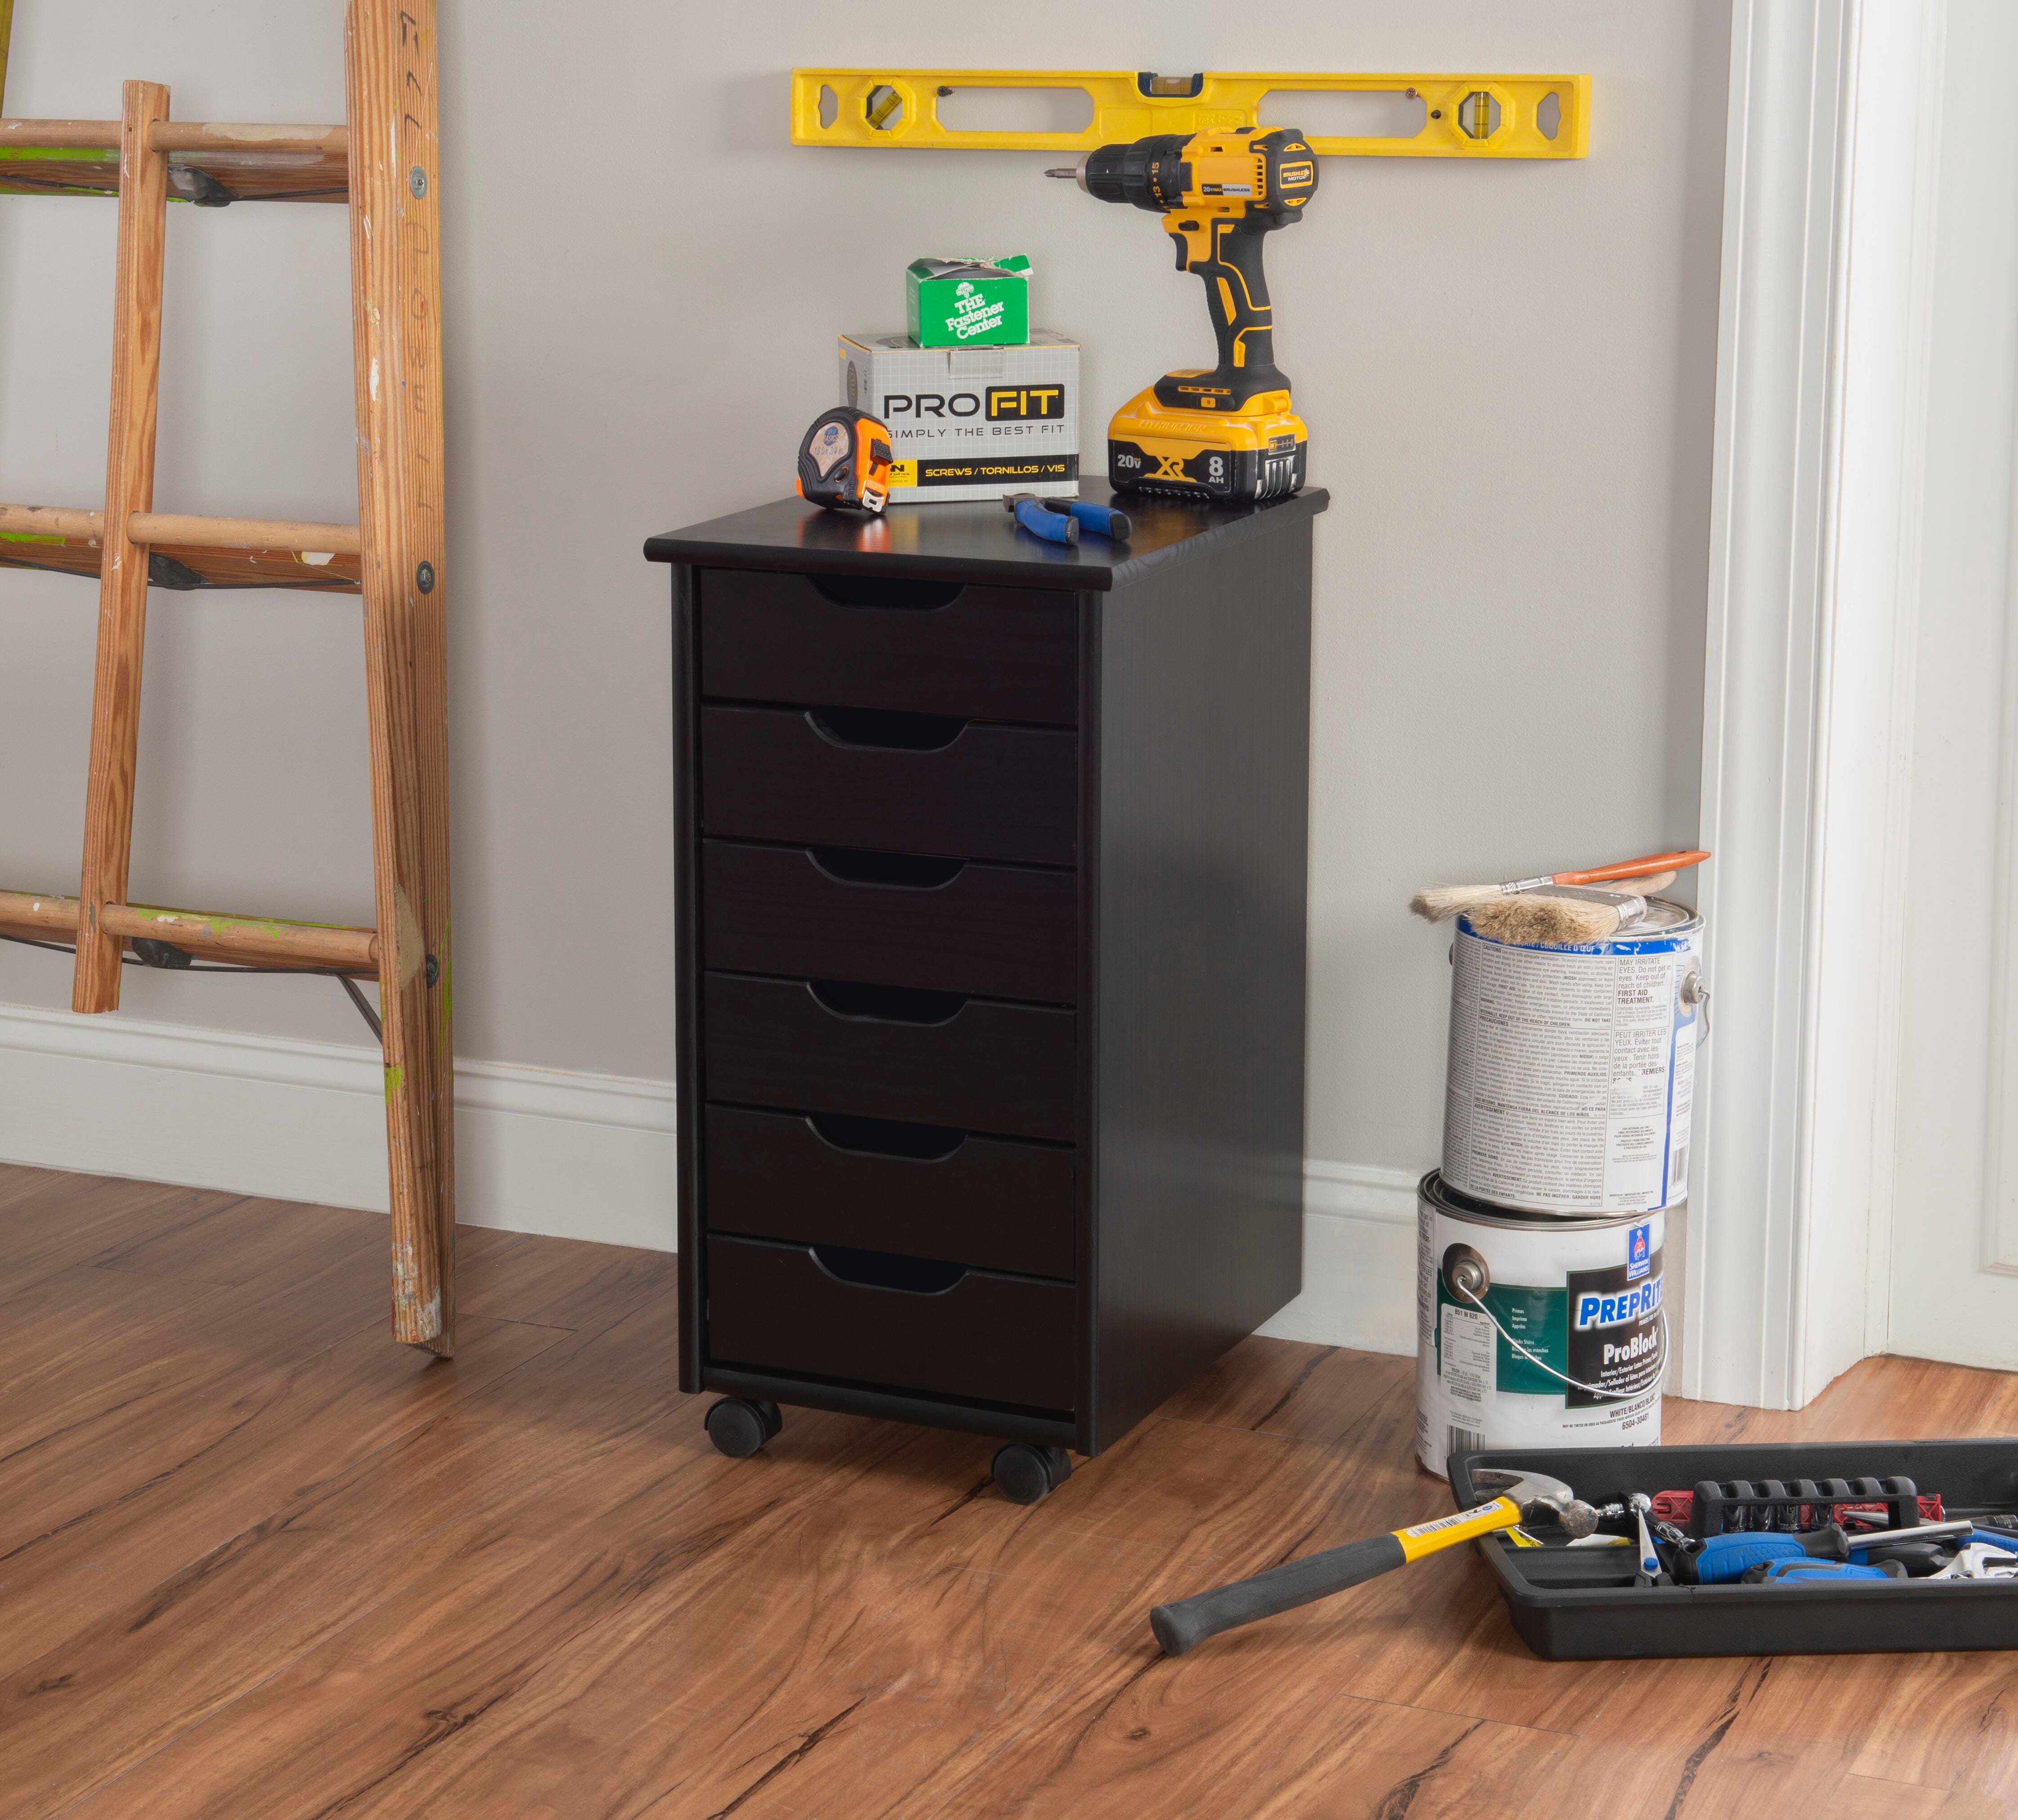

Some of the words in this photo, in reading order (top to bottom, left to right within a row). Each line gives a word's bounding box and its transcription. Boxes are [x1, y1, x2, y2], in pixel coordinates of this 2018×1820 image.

[1152, 162, 1159, 175] 15
[1153, 186, 1161, 197] 13
[954, 294, 985, 314] THE
[945, 301, 1004, 331] Fastener
[957, 315, 1002, 339] Center
[955, 428, 984, 436] THE
[993, 426, 1034, 435] BEST
[1042, 425, 1065, 434] FIT
[815, 447, 820, 455] 16
[926, 468, 972, 477] SCREWS
[980, 466, 1039, 475] TORNILLOS
[1209, 456, 1223, 476] 8
[1484, 945, 1501, 953] CAUTIONS
[1479, 1015, 1509, 1027] PRECAUCIONES
[1635, 1037, 1650, 1045] Éviter
[1638, 1066, 1665, 1076] REMIERS
[1475, 1104, 1505, 1115] AVERTISSEMENT
[1630, 1258, 1649, 1270] SHERWIN
[1629, 1265, 1649, 1277] WILLIAMS
[1604, 1326, 1657, 1364] ProBlock
[1601, 1365, 1633, 1378] Interior/Exterior
